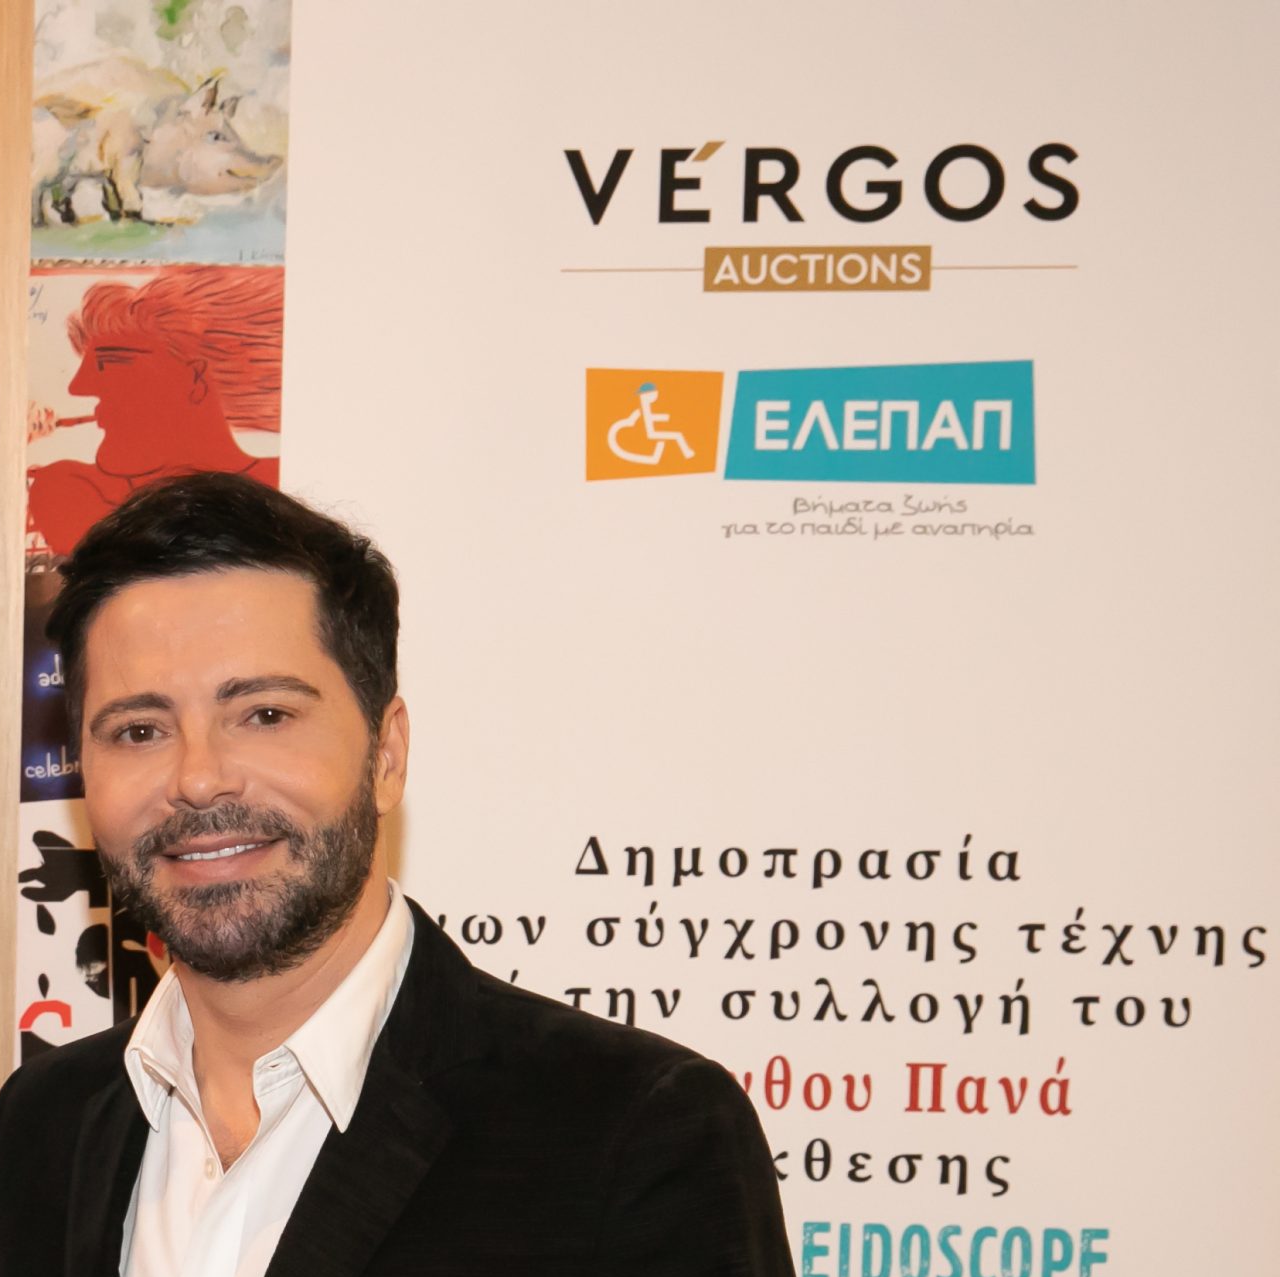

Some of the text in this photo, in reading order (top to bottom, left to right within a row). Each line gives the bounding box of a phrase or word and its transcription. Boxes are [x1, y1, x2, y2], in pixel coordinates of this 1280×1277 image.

[564, 141, 1080, 225] VÉRGOS
[713, 253, 923, 285] AUCTIONS
[754, 400, 1013, 451] ΕΛΕΠΑΠ
[721, 521, 761, 538] για
[766, 521, 796, 535] το
[873, 521, 903, 540] με
[574, 833, 1022, 890] Δημοπρασία
[438, 900, 1269, 969] ων σύγχρονης τέχνης
[720, 977, 1031, 1035] συλλογή
[1072, 996, 1194, 1028] του
[904, 1056, 1074, 1117] Πανά
